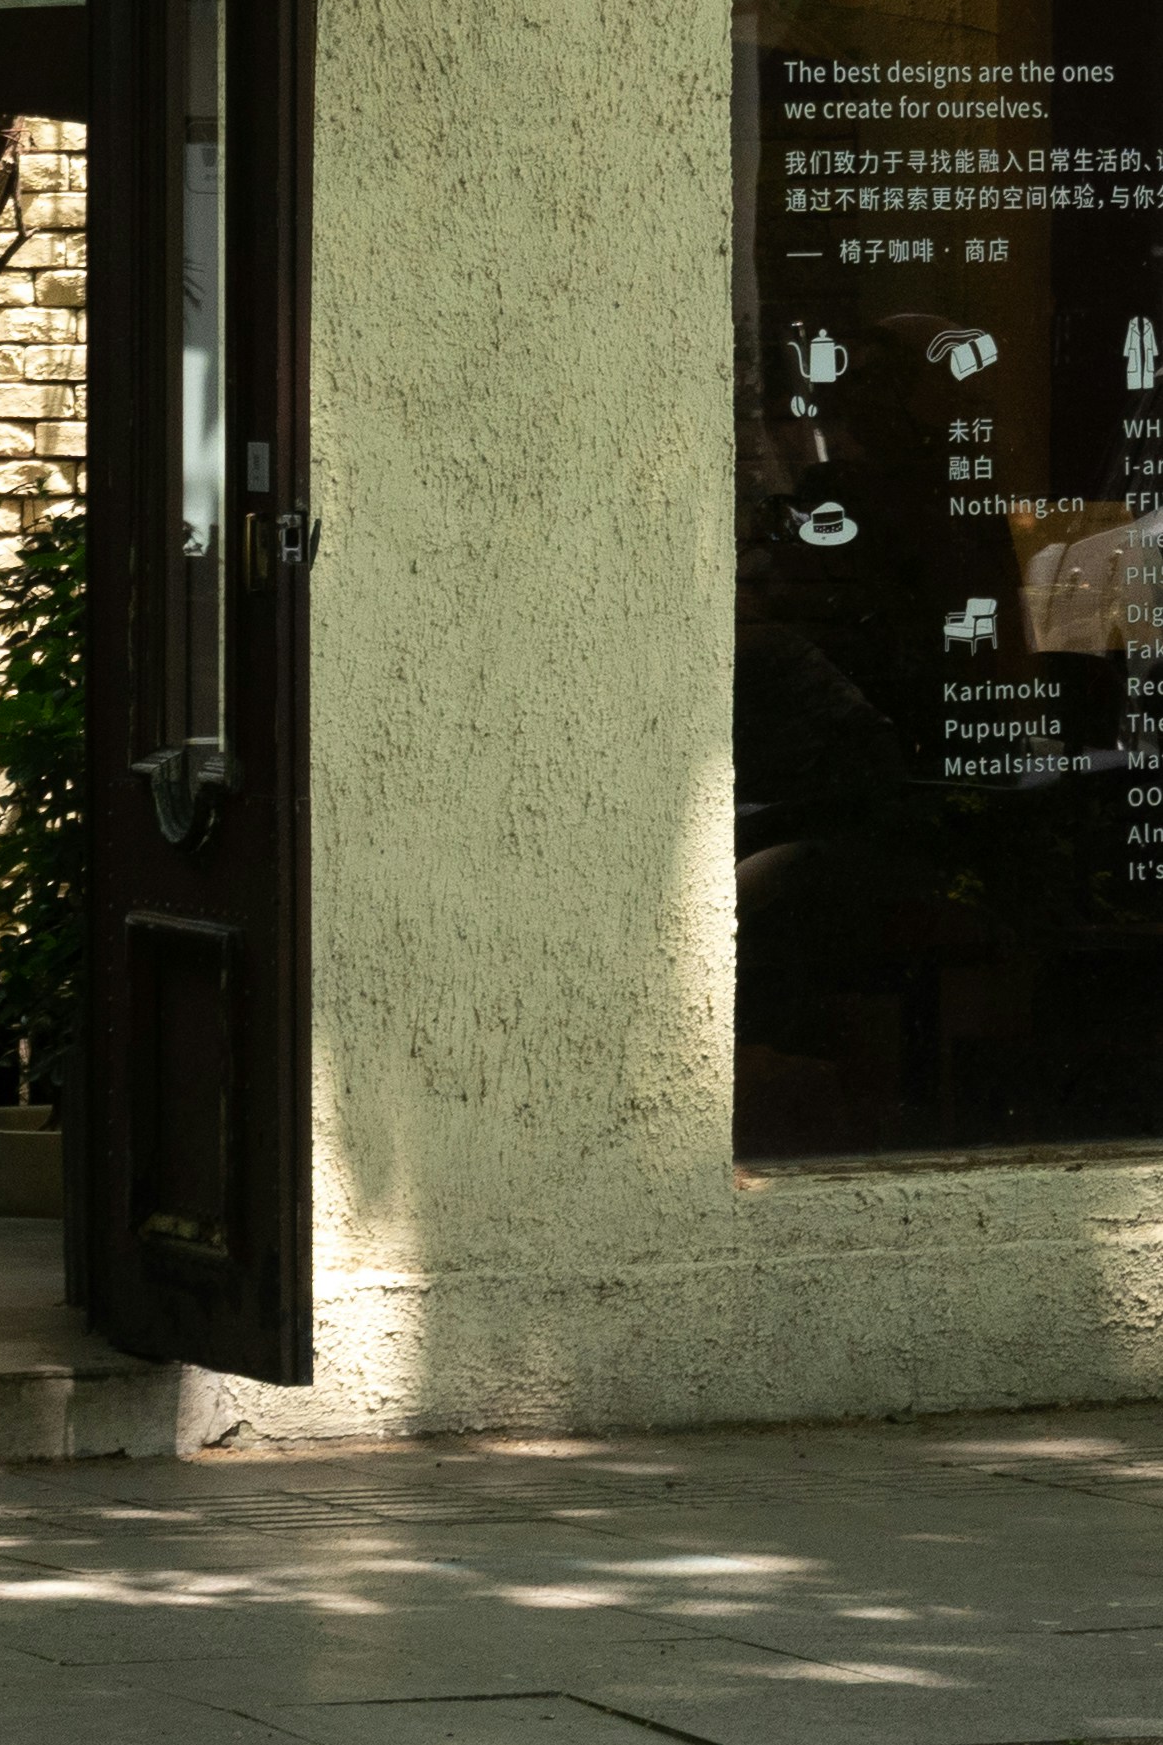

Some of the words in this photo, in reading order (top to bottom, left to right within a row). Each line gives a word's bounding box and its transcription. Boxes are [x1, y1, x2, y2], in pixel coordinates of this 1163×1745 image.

[784, 61, 825, 83] The
[834, 60, 880, 83] best
[887, 60, 971, 89] designs
[979, 66, 1013, 82] are
[1020, 60, 1055, 82] the
[1063, 66, 1114, 82] ones
[785, 103, 815, 119] we
[823, 99, 892, 119] create
[899, 96, 930, 118] for
[937, 96, 1048, 118] ourselves.
[786, 148, 1163, 175] 我们致力于寻找能融入日常生活的、
[786, 184, 1163, 211] 通过不断探索更好的空间体验，与你
[840, 239, 933, 263] 椅子咖啡
[965, 238, 1009, 262] 商店
[949, 418, 993, 443] 未行
[949, 455, 991, 480] 融白
[949, 494, 1085, 518] Nothing.cn
[1127, 566, 1163, 585] PH
[943, 678, 1062, 702] Karimoku
[944, 715, 1062, 743] Pupupula
[944, 754, 1092, 777] Metalsistem
